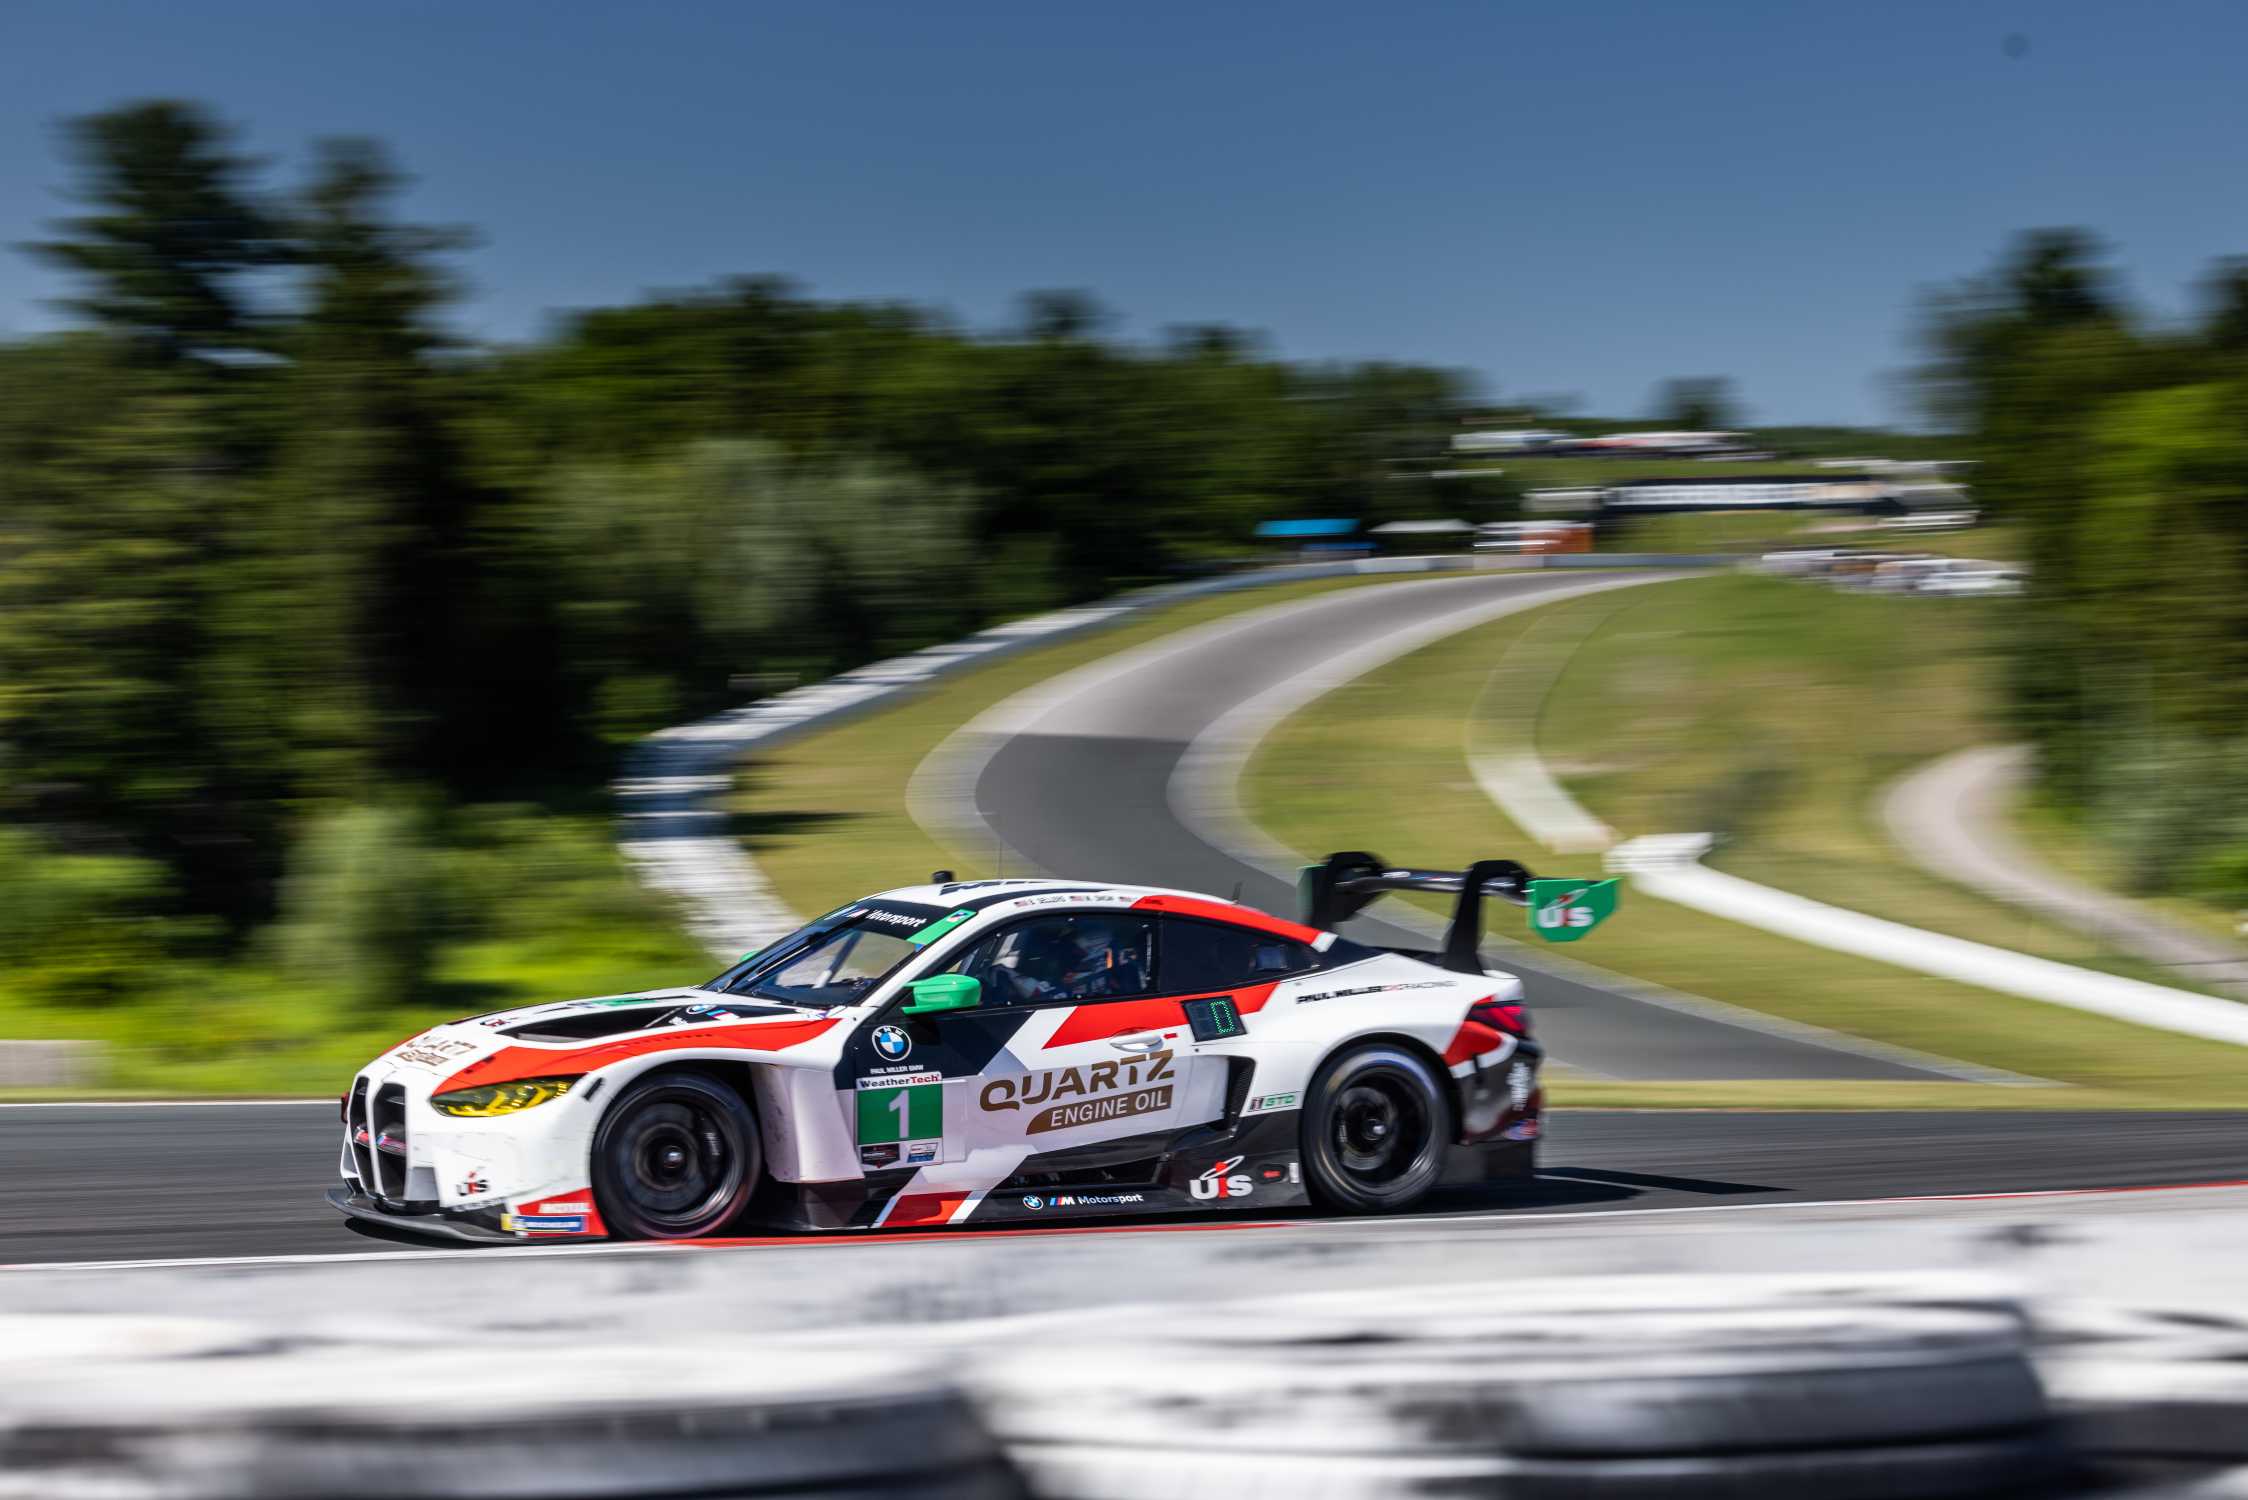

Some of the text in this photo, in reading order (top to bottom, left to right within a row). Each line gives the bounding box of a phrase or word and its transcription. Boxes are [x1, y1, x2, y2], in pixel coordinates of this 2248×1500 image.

[860, 1074, 940, 1089] WeatherTech
[980, 1049, 1175, 1112] QUARTZ
[888, 1089, 910, 1139] 1
[1050, 1091, 1168, 1127] ENGINE OIL
[1077, 1194, 1144, 1205] Motorsport
